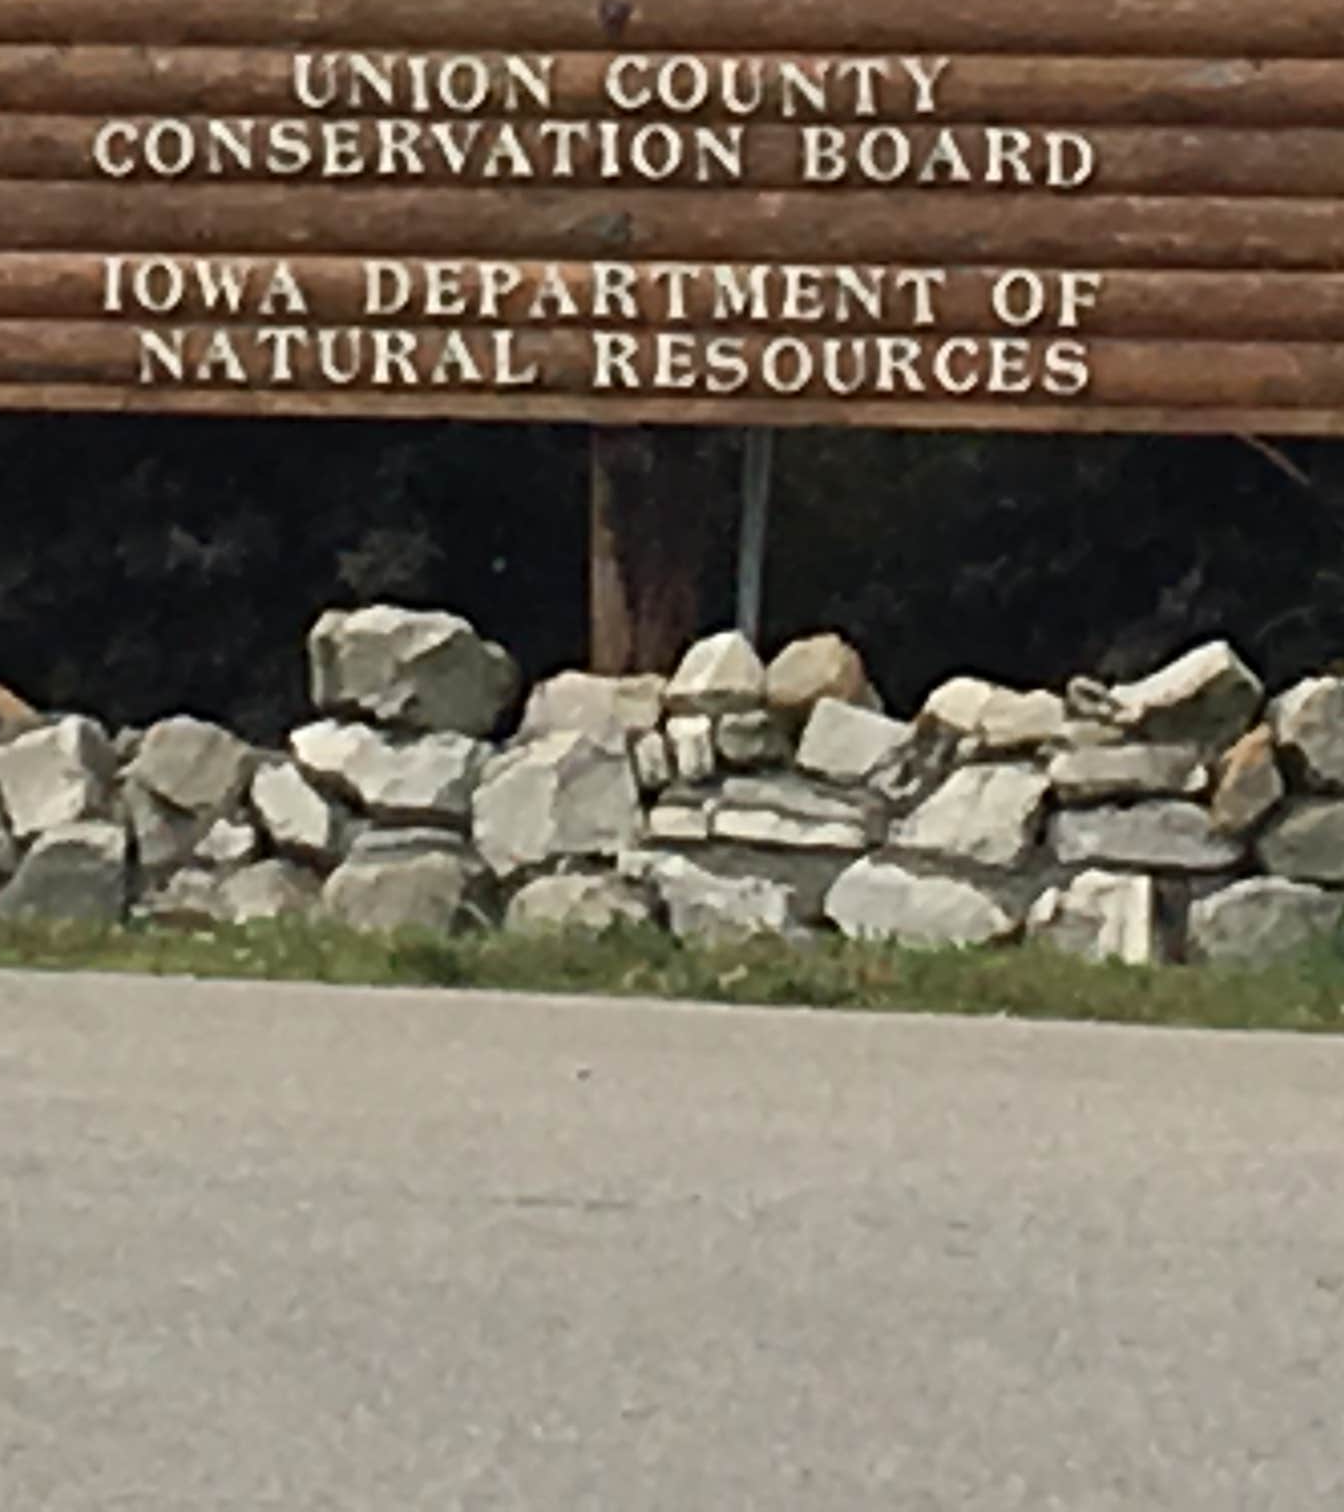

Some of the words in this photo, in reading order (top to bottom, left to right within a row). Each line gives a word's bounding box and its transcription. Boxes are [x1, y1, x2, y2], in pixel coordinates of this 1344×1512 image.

[291, 52, 554, 112] UNION
[606, 55, 953, 117] COUNTY
[92, 119, 743, 180] CONSERVATION
[802, 124, 1096, 189] BOARD
[102, 258, 309, 314] IOWA
[364, 259, 946, 326] DEPARTMENT
[991, 270, 1104, 330] OF
[138, 326, 539, 387] NATURAL
[592, 332, 1092, 397] RESOURCES
